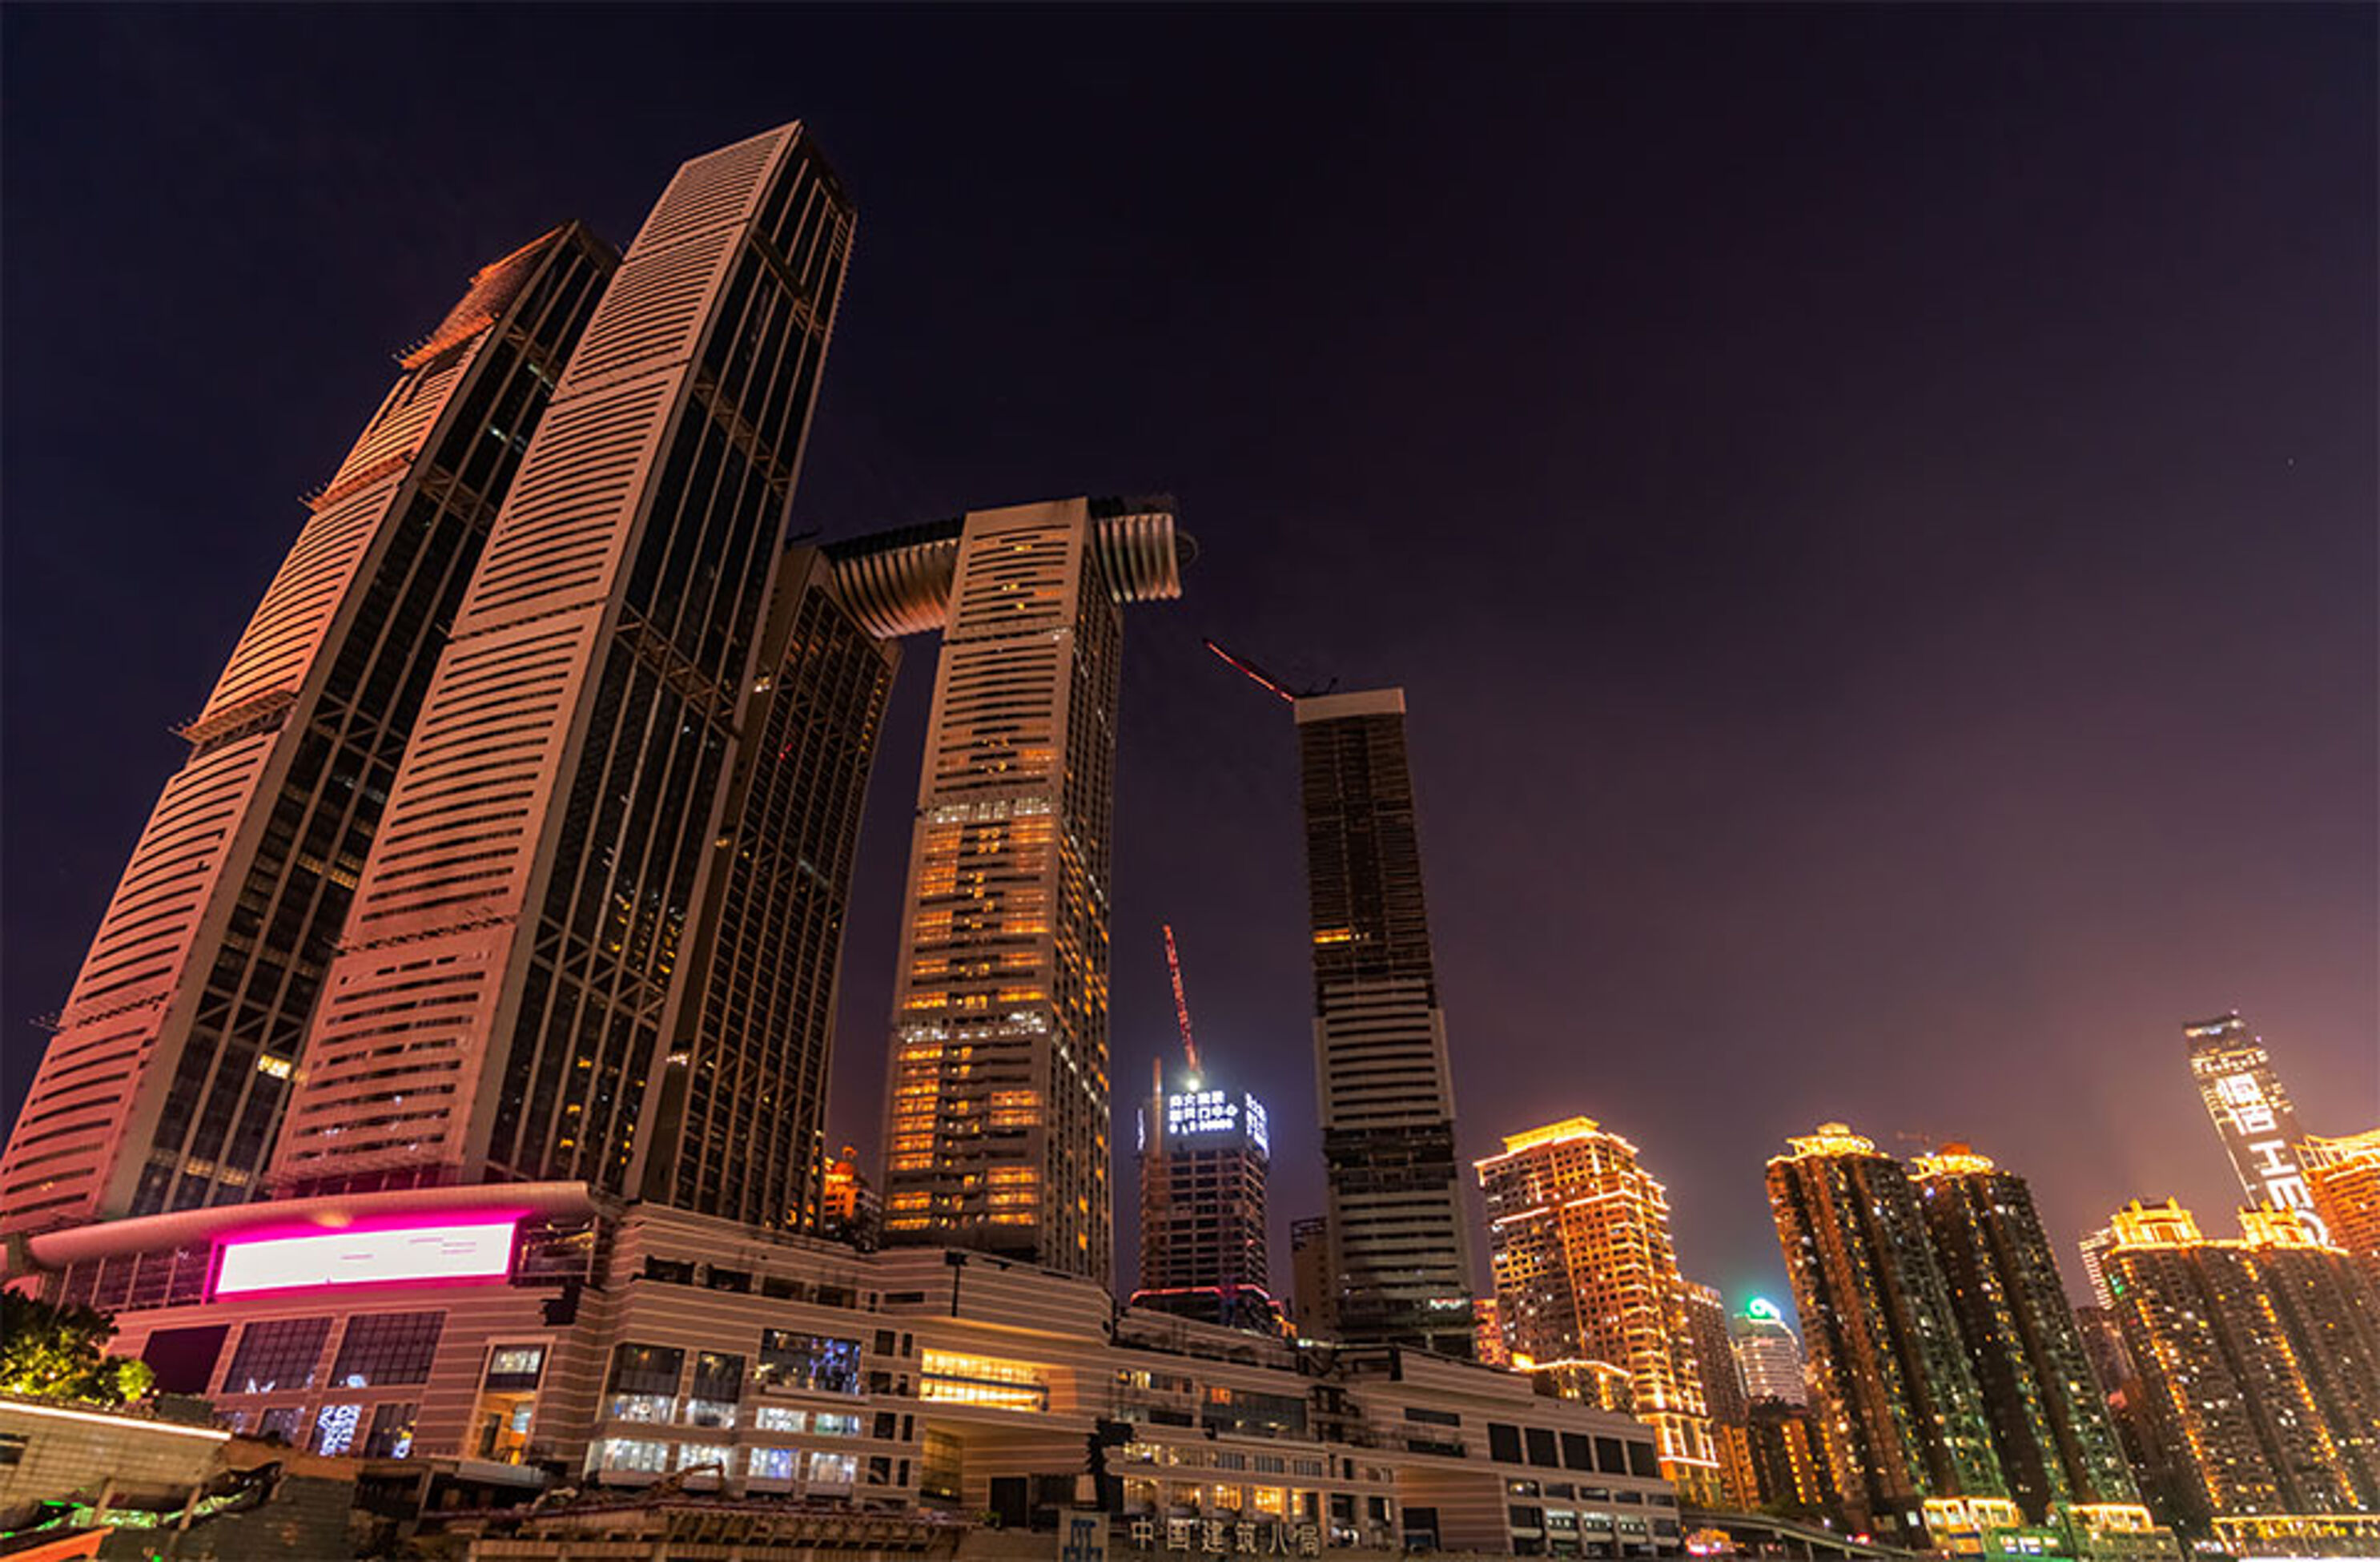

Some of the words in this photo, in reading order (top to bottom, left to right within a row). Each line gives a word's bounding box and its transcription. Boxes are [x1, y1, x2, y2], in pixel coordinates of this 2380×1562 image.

[1131, 1516, 1321, 1556] 中国建筑八局
